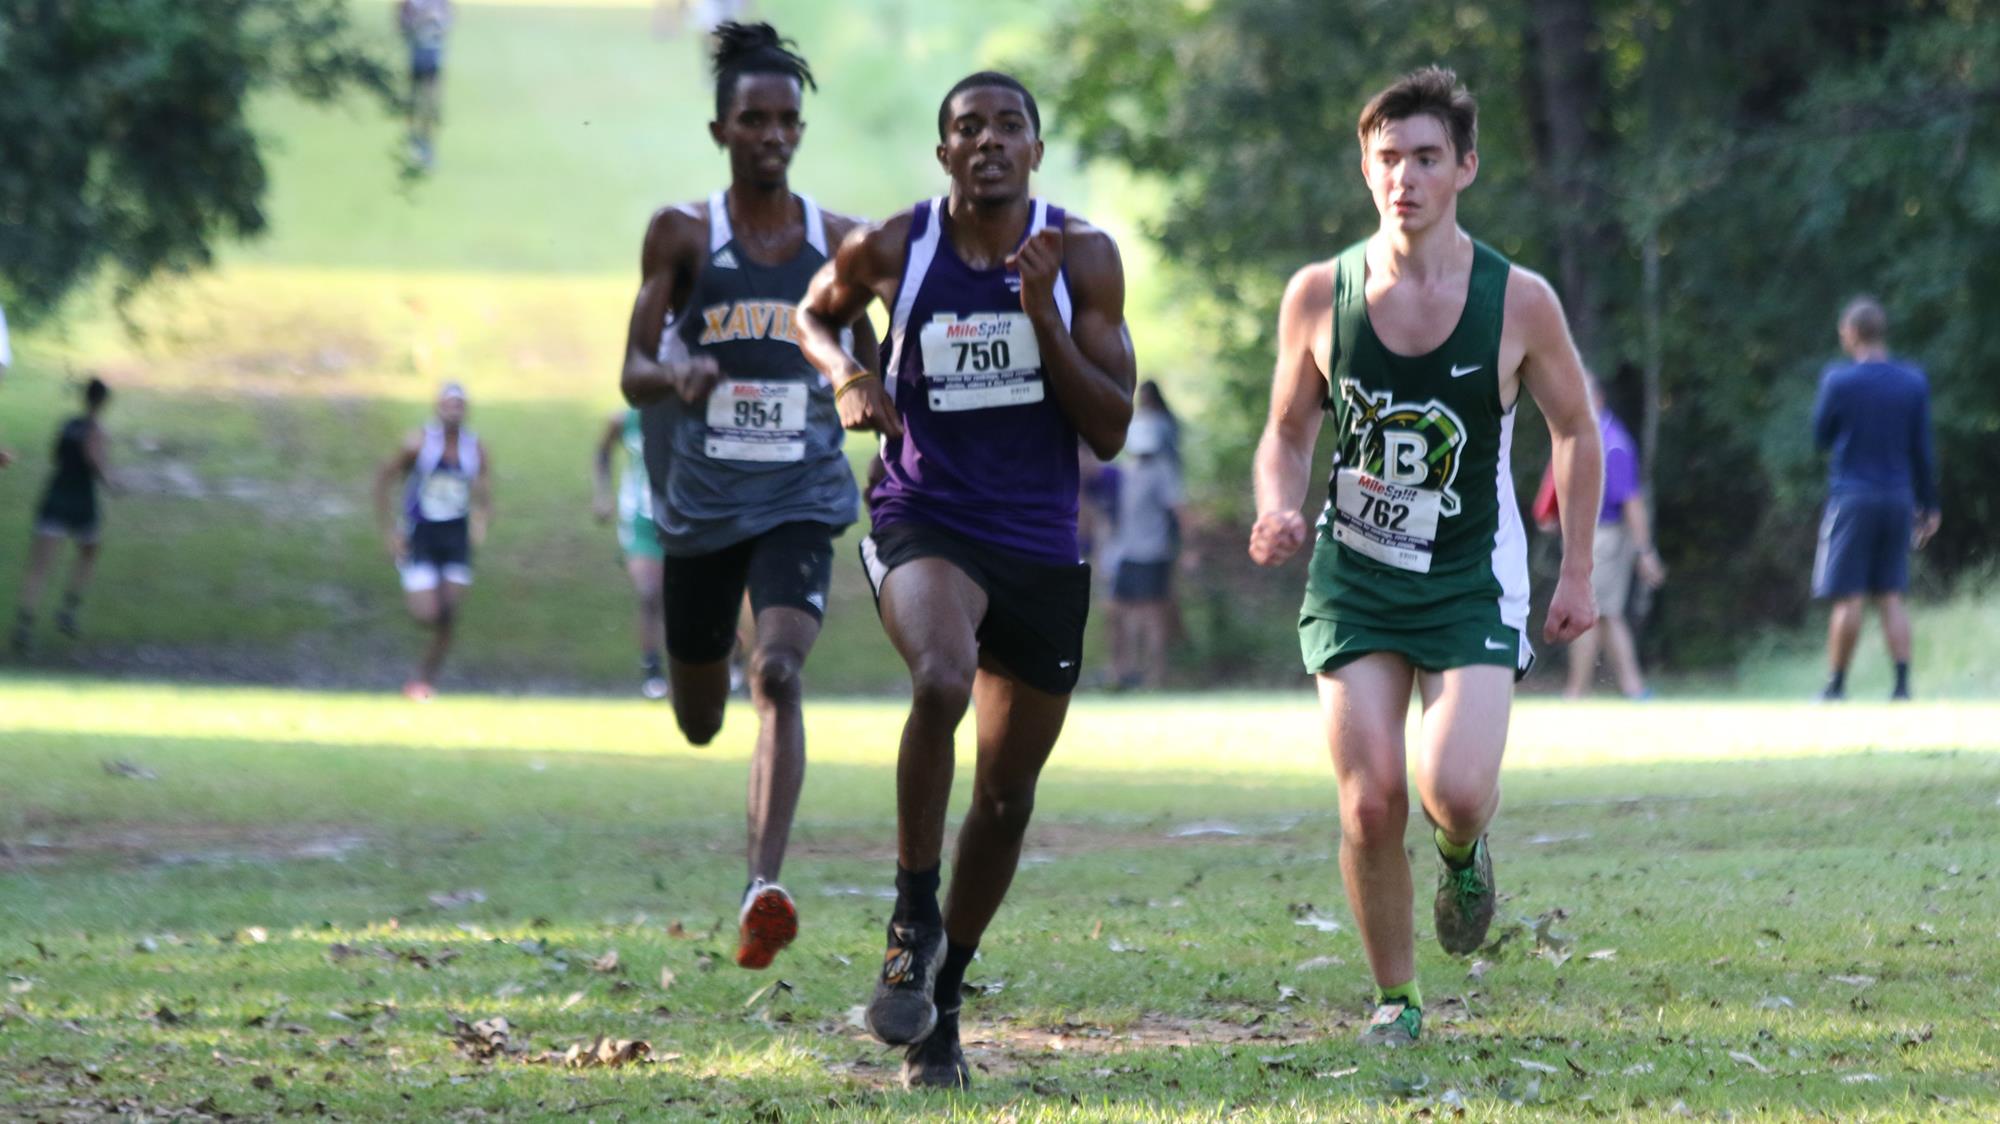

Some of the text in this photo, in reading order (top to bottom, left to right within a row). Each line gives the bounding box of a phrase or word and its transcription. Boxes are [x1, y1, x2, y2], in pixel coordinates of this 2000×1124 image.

[946, 320, 1012, 338] MileSplit
[951, 340, 1011, 373] 750
[734, 400, 783, 429] 954
[1383, 429, 1429, 487] B
[1358, 475, 1418, 502] MileSplit
[1359, 491, 1410, 533] 762
